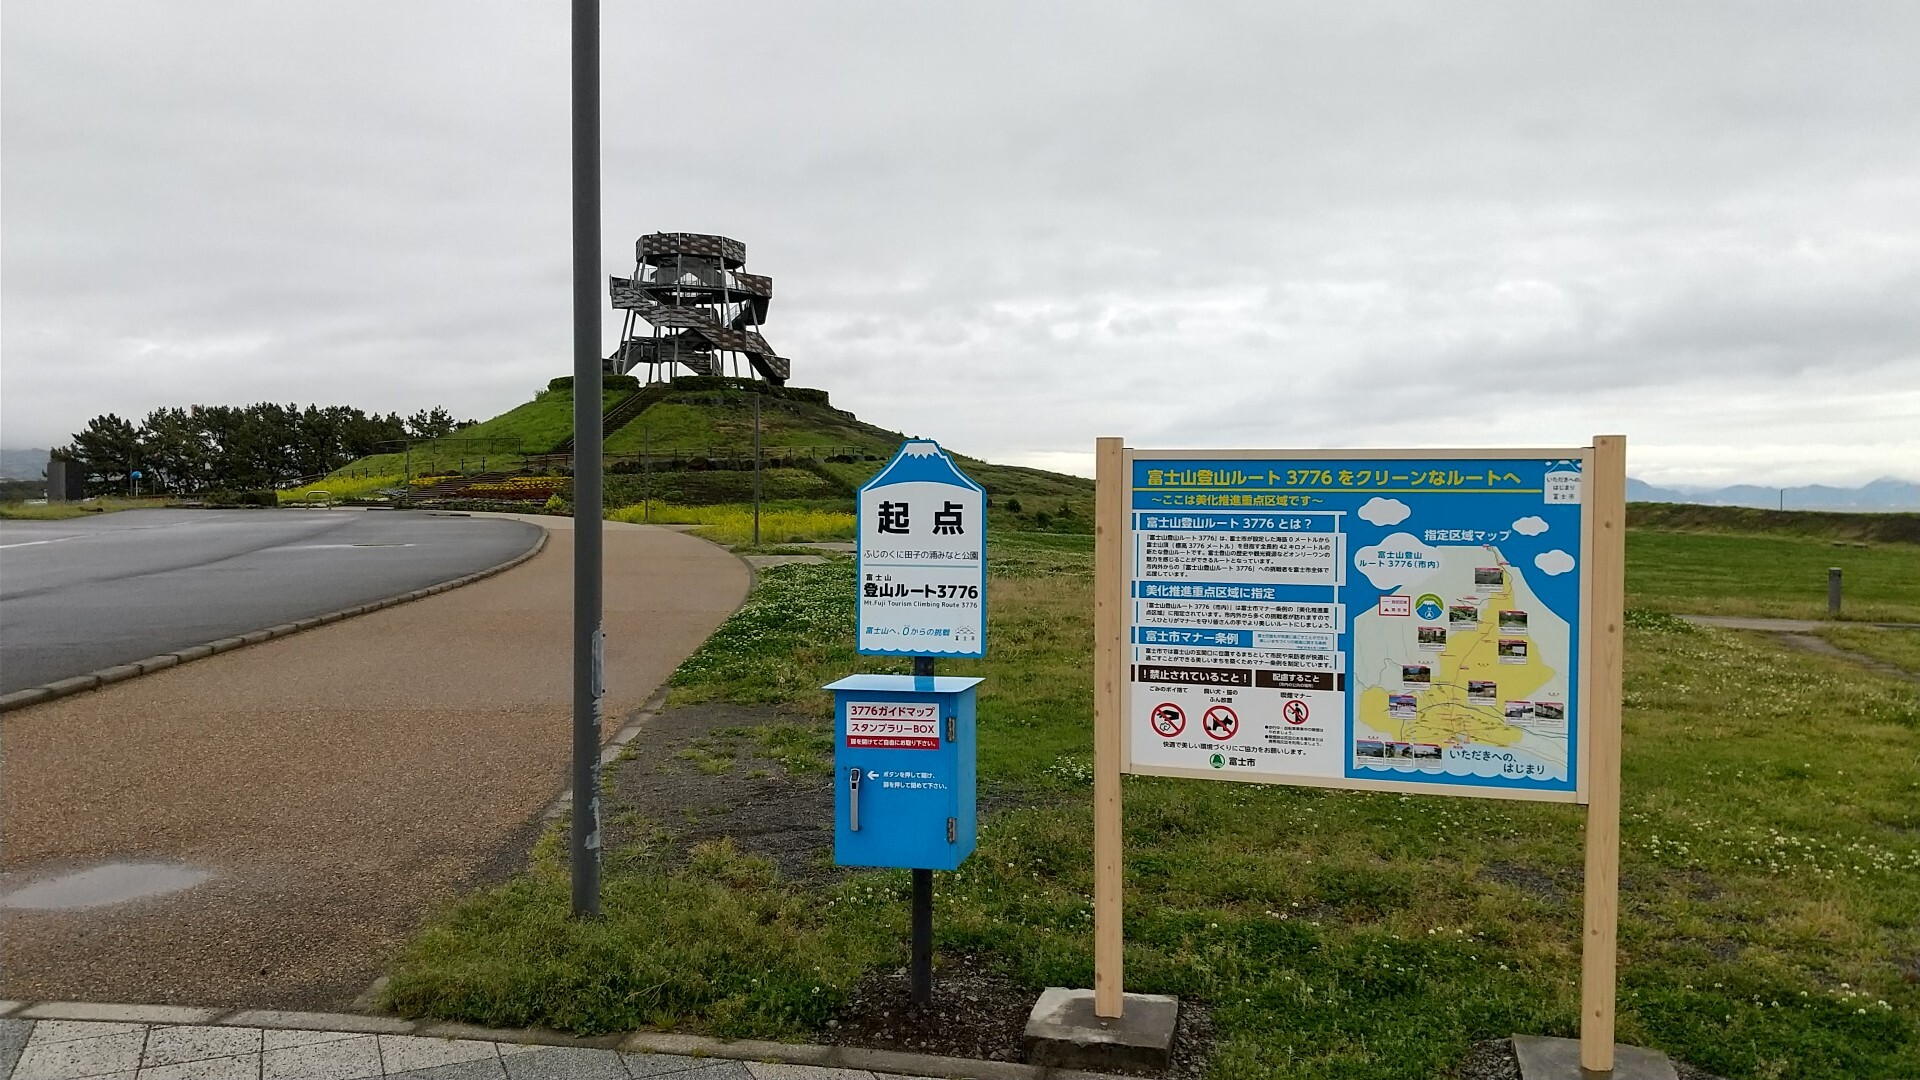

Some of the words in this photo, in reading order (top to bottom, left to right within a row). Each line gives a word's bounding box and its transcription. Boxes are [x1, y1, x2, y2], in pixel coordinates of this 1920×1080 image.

[1147, 469, 1281, 486] 富士山登山ルート
[1286, 470, 1333, 486] 3776
[1338, 469, 1521, 487] をクリーンなルートへ
[1146, 516, 1240, 530] 富士山登山ルート
[1243, 518, 1275, 530] 3776
[1278, 518, 1312, 530] とは？
[1424, 529, 1512, 542] 指定区域マップ
[1189, 542, 1205, 550] 3776
[1377, 551, 1423, 560] 富士山登山
[1359, 559, 1385, 568] ルート
[866, 574, 892, 582] 富士山
[863, 582, 979, 599] 登山ルート3776
[1146, 584, 1276, 600] 美化推進重点区域に指定
[1145, 630, 1240, 645] 富士市マナー条例
[1272, 673, 1320, 683] 配慮すること
[851, 705, 936, 718] 3776ガイドマップ
[851, 723, 935, 734] スタンプラリーBOX
[850, 738, 937, 748] 扉を開けてご自由にお取り下さい。
[1228, 757, 1256, 767] 富士市
[1449, 749, 1518, 763] いただきへの、
[1503, 763, 1546, 775] はじまり
